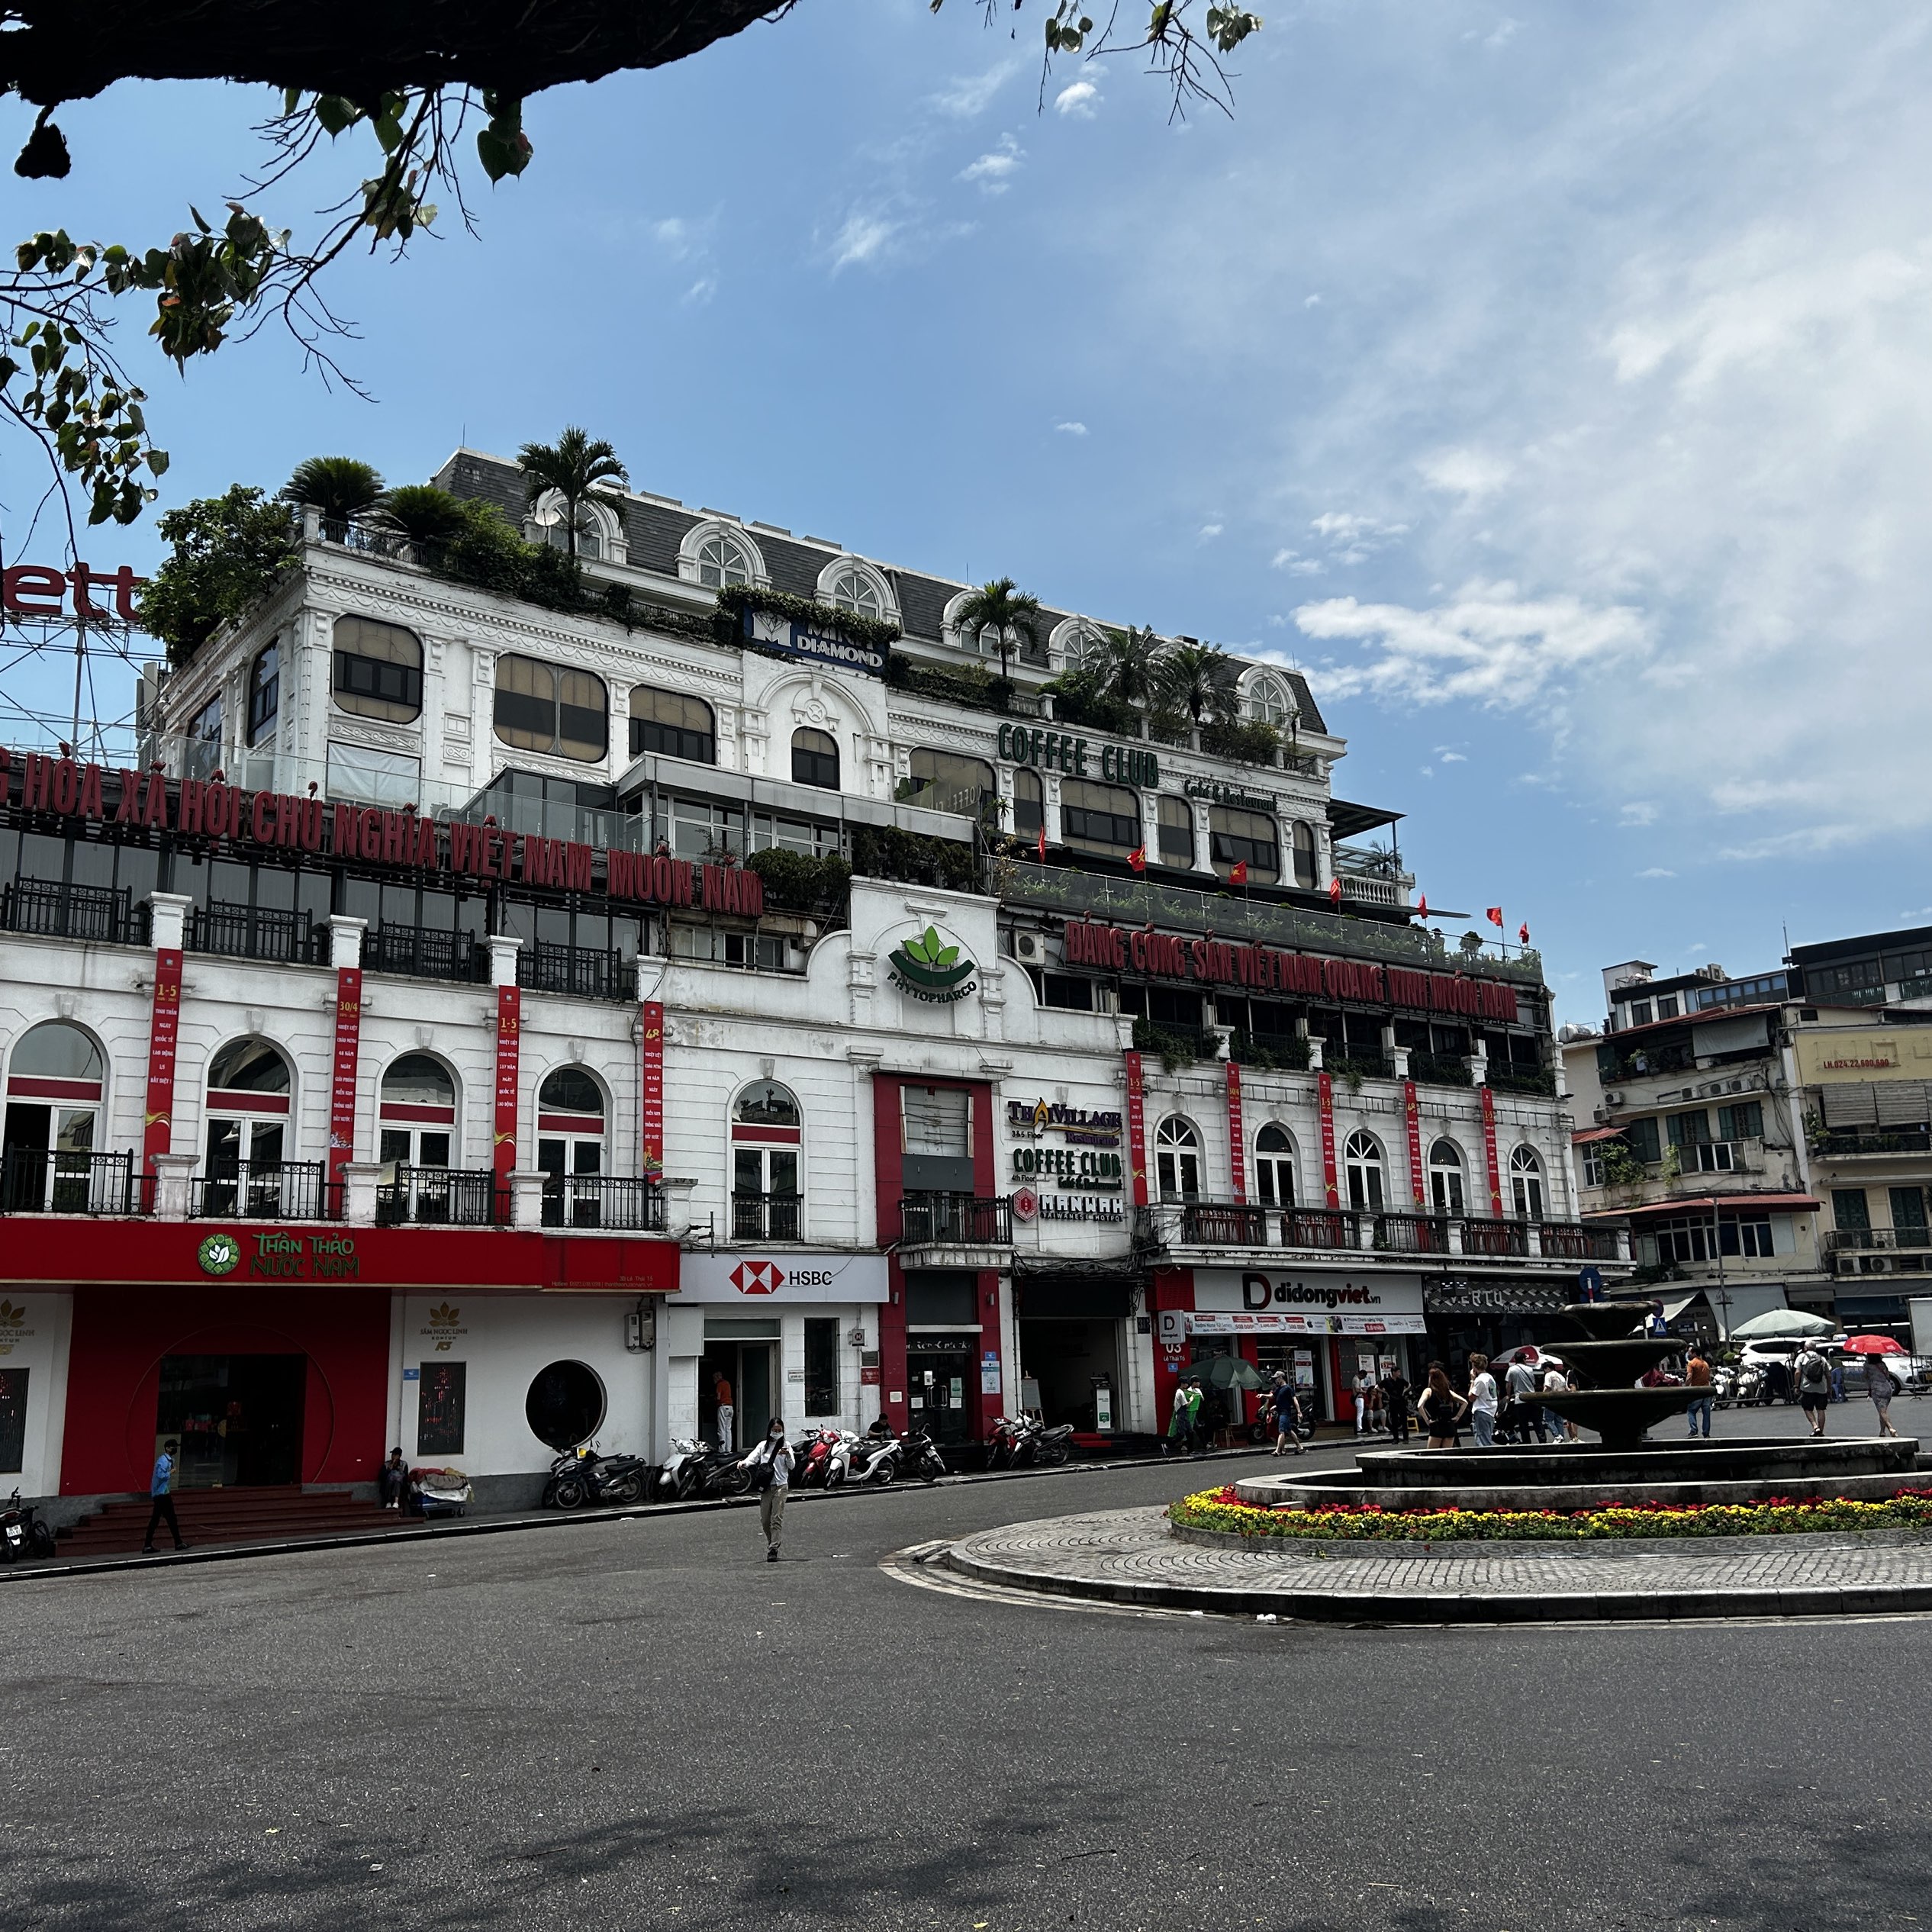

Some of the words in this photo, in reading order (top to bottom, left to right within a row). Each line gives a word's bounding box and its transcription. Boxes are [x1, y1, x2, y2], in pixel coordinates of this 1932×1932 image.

[797, 635, 883, 668] DIAMOND
[999, 723, 1087, 776] COFFEE
[1102, 745, 1158, 788] CLUB
[1184, 779, 1210, 797] Café
[1212, 785, 1219, 800] &
[1224, 788, 1277, 812] Restaurant
[22, 743, 103, 819] HÒA
[114, 760, 167, 829] XÃ
[179, 769, 239, 850] HỘI
[252, 781, 322, 852] CHỦ
[333, 803, 436, 869] NGHĨA
[450, 815, 517, 887] VIỆT
[523, 834, 591, 893] NAM
[702, 855, 763, 918] NĂM
[1065, 911, 1125, 968] ĐẢNG
[1131, 923, 1185, 981] CỘNG
[1192, 929, 1232, 983] SẢN
[1236, 939, 1275, 995] VIỆT
[1279, 953, 1322, 995] NAM
[1324, 958, 1385, 1002] QUANG
[1386, 968, 1428, 1009] VINH
[1480, 974, 1518, 1021] NĂM
[158, 984, 176, 997] 1-5
[887, 971, 977, 1003] PHYTOPHARCO
[340, 1001, 358, 1012] 30/4
[501, 1017, 517, 1029] 1-5
[1130, 1077, 1140, 1087] 1-5
[1322, 1097, 1331, 1106] 1-5
[1013, 1148, 1074, 1174] COFFEE
[1081, 1151, 1121, 1177] CLUB
[1040, 1194, 1123, 1213] MANWAH
[1042, 1212, 1089, 1220] TAIWANESE
[250, 1254, 304, 1277] NƯỚC
[312, 1255, 359, 1277] NAM
[789, 1270, 832, 1285] HSBC
[1275, 1282, 1380, 1308] didongviet.vn
[1164, 1315, 1175, 1331] D
